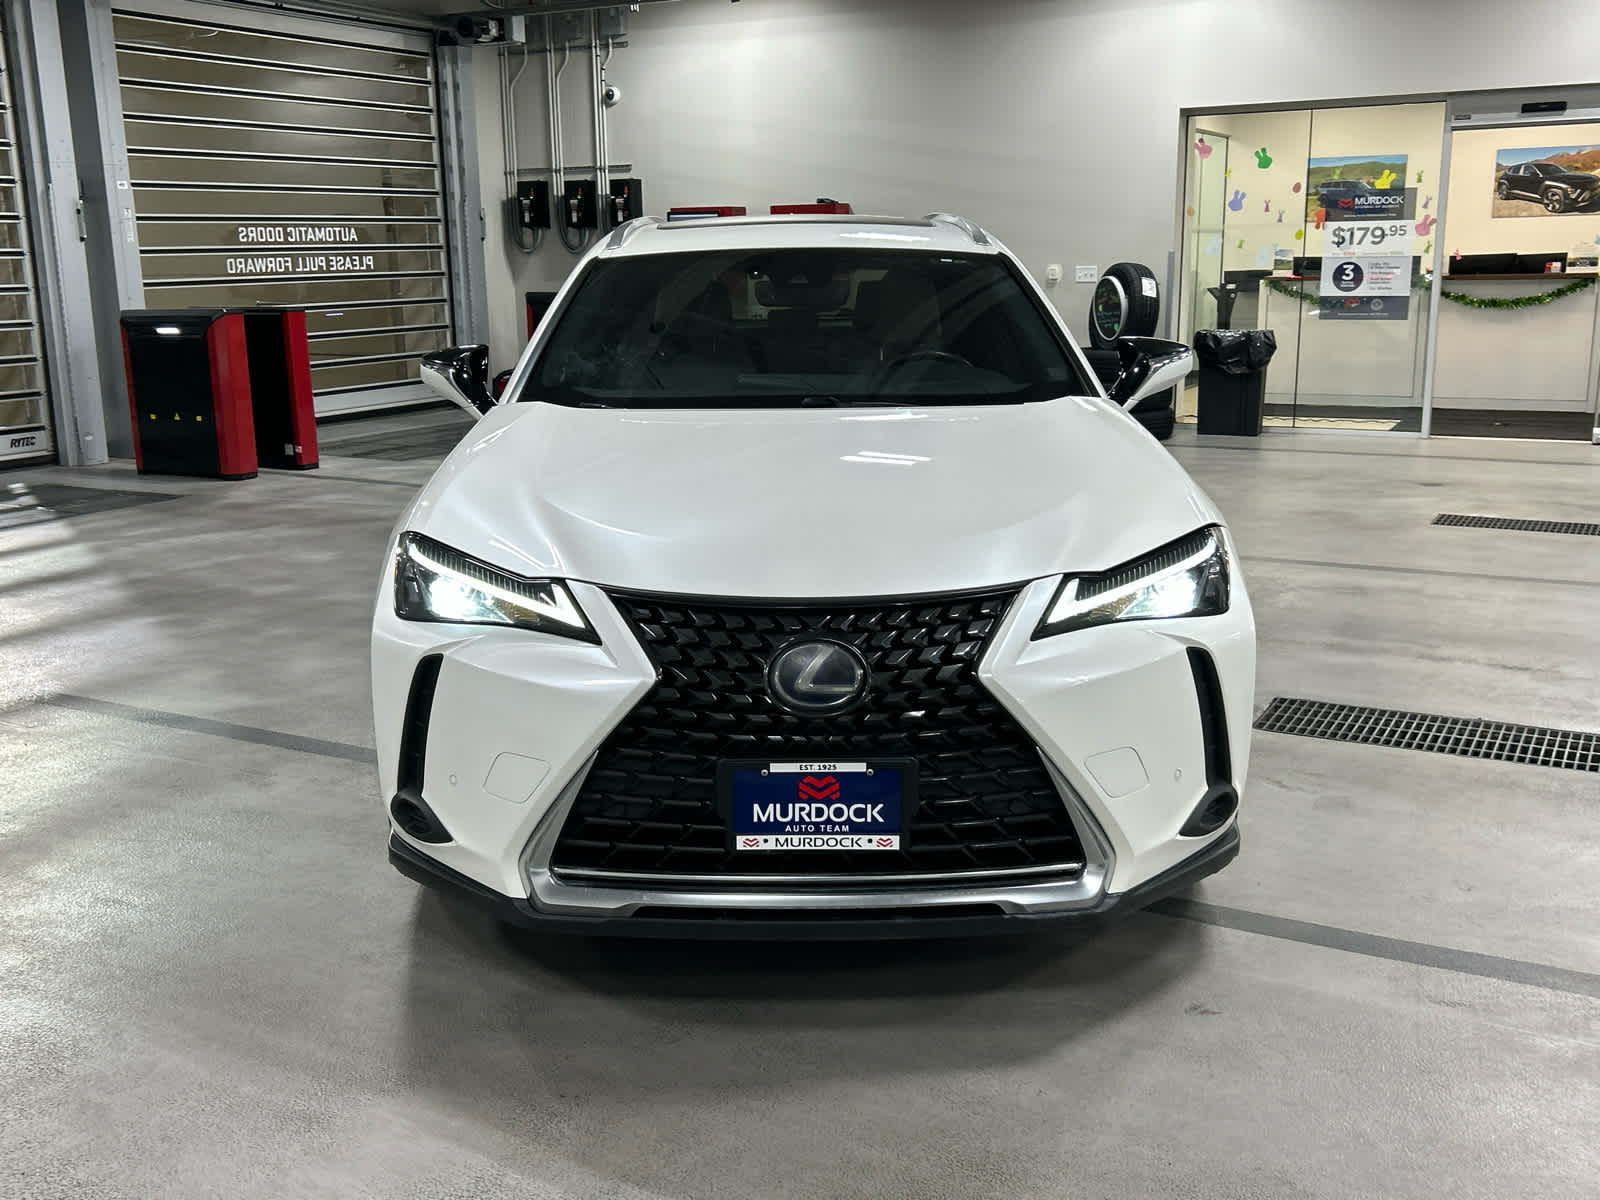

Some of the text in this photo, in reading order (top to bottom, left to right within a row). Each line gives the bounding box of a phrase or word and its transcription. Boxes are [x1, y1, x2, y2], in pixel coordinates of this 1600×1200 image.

[1354, 195, 1404, 206] MURDOCK
[1341, 264, 1355, 281] 3
[752, 803, 885, 823] MURDOCK
[785, 824, 850, 833] AUTO TEAM
[775, 837, 863, 848] MURDOCK
